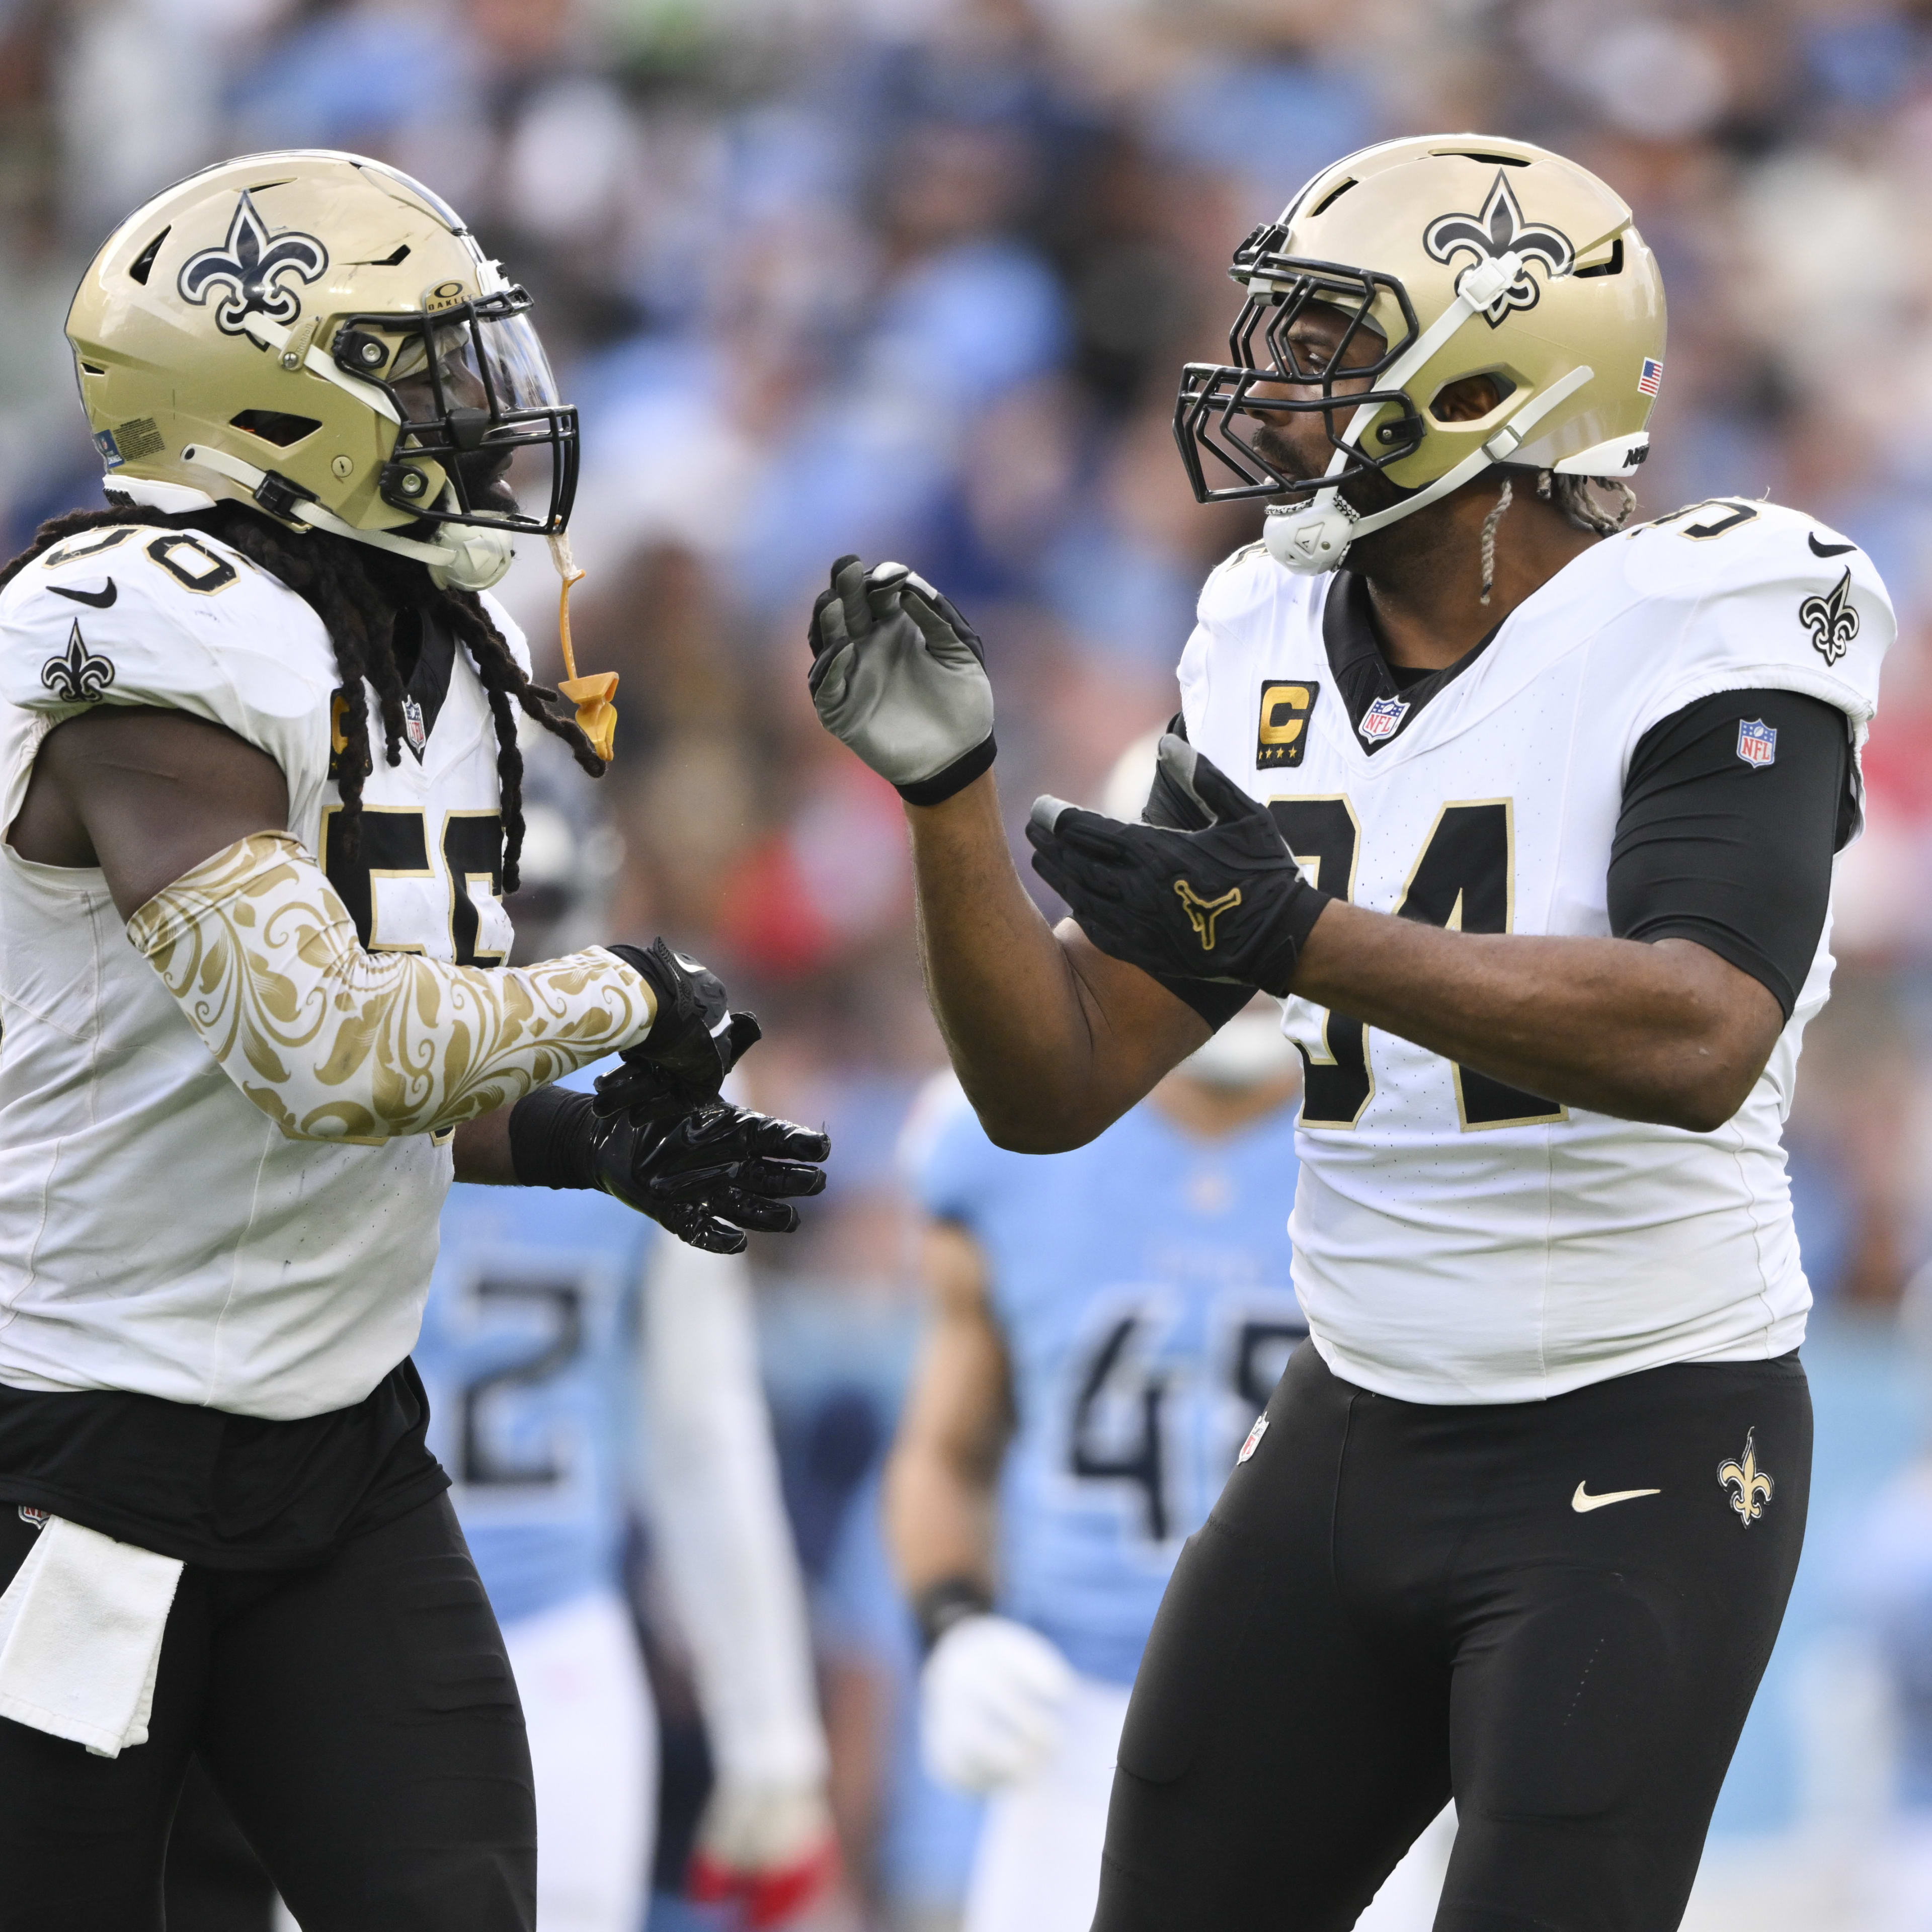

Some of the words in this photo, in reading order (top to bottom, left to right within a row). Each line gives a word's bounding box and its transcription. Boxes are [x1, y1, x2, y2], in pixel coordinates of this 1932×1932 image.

[428, 294, 473, 310] OAKLEY
[1260, 686, 1310, 745] C
[1365, 714, 1392, 734] NFL
[1741, 737, 1770, 761] NFL
